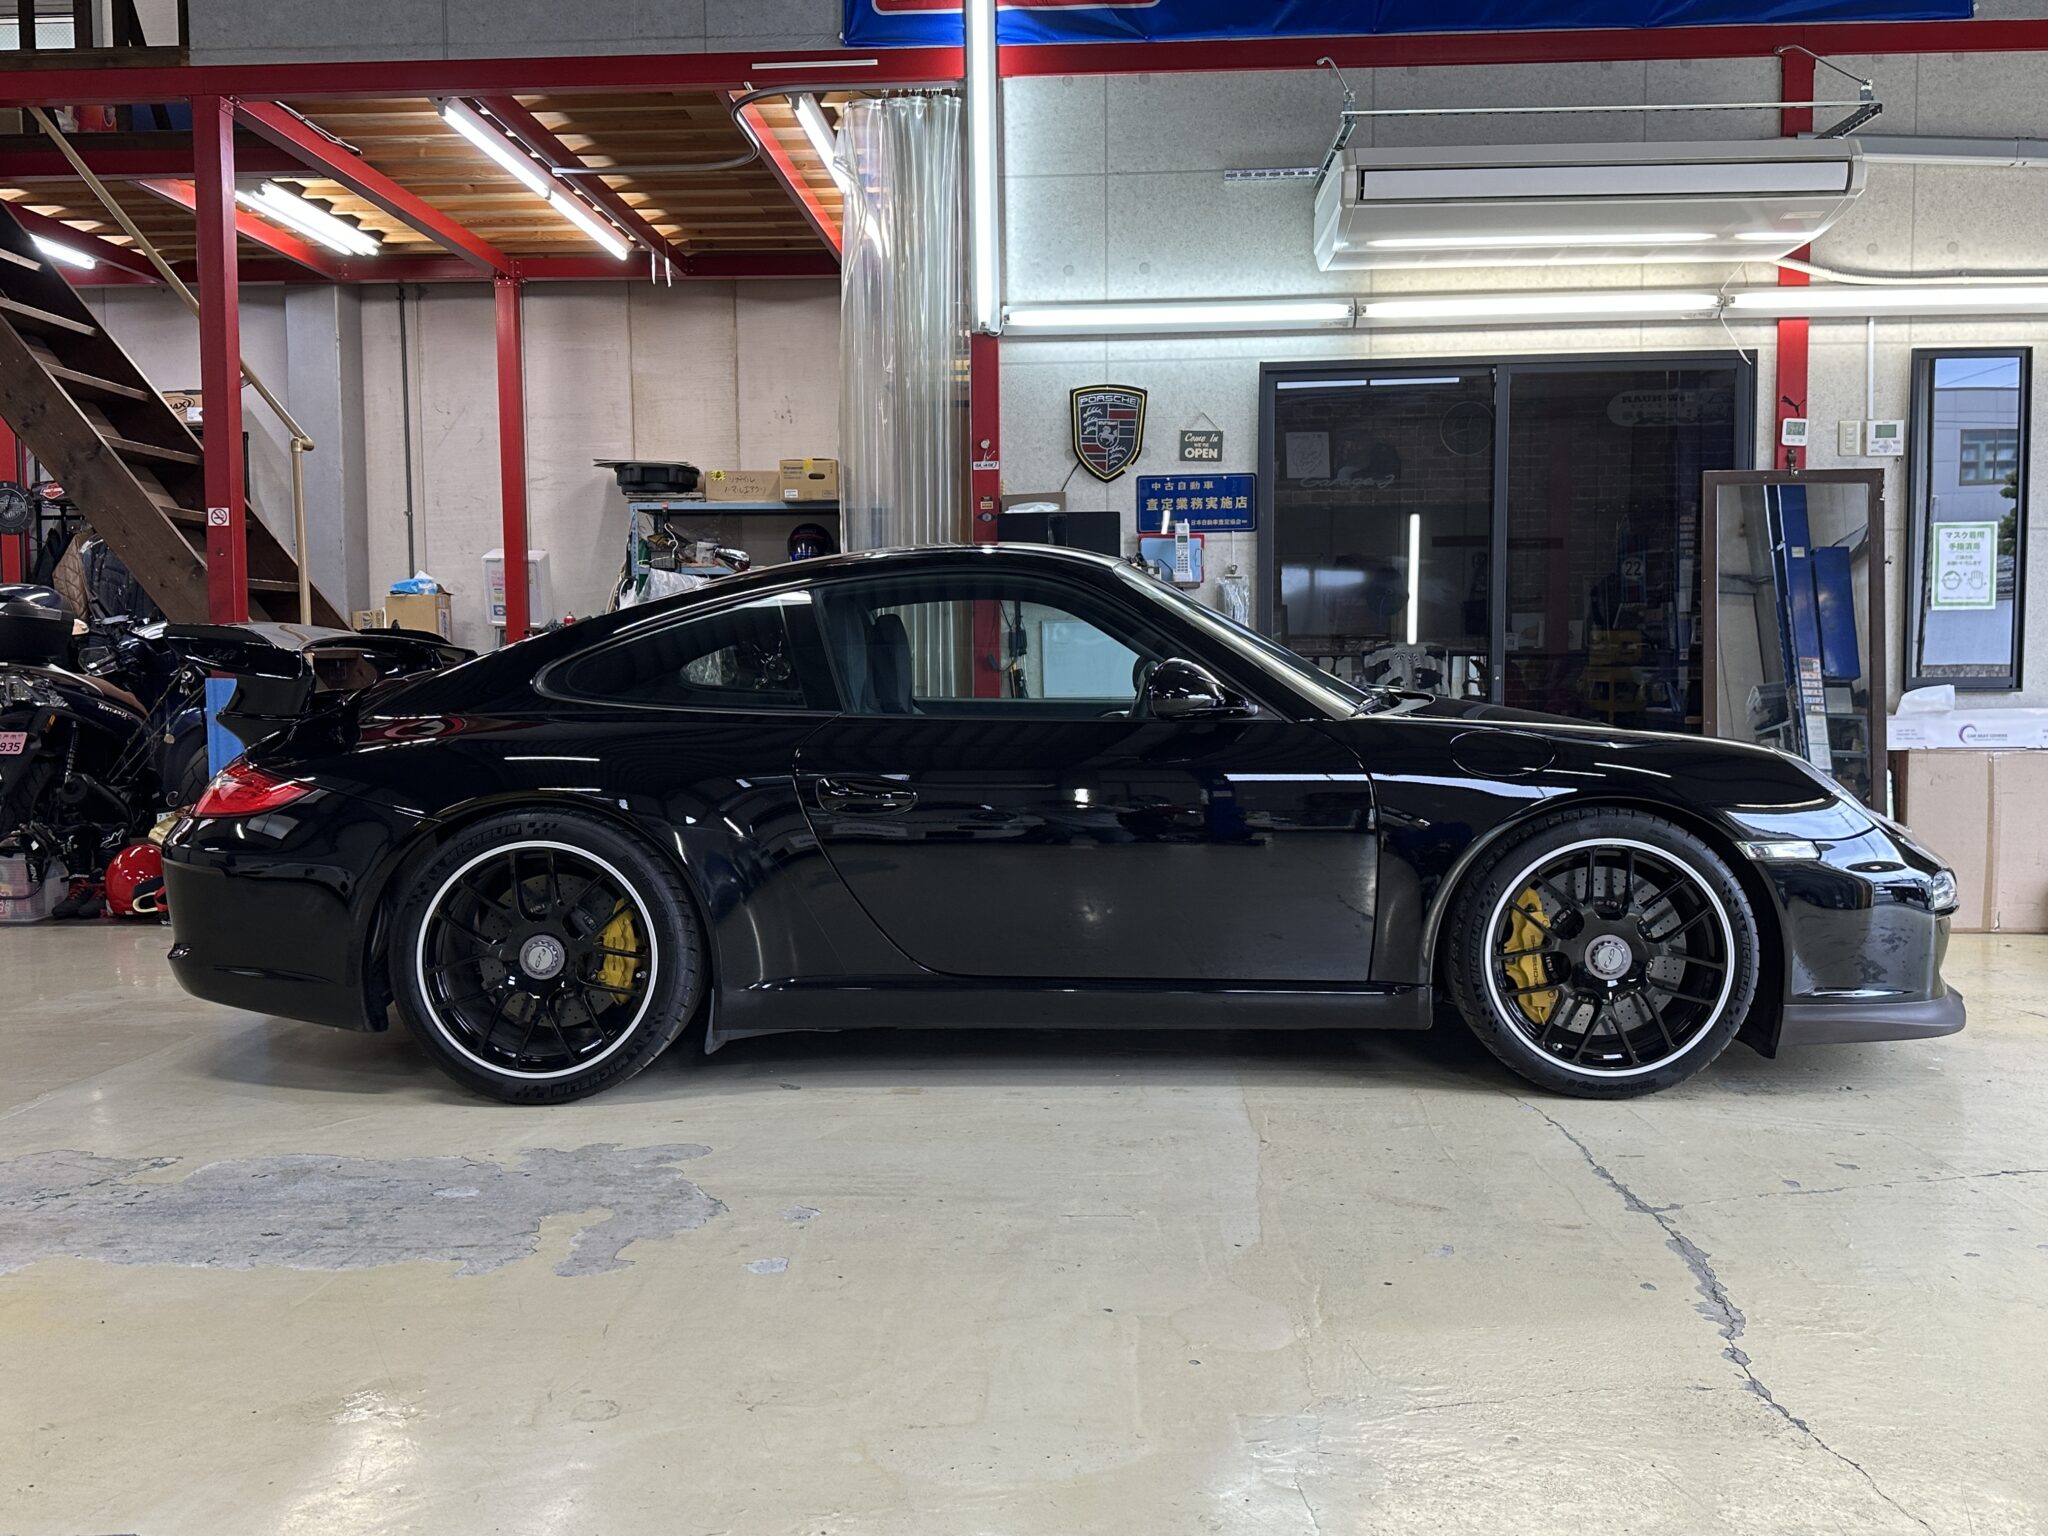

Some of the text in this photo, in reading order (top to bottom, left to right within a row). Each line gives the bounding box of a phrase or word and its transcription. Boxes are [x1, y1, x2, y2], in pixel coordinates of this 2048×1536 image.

[169, 401, 187, 410] AX
[1079, 395, 1138, 406] PORSCHE
[1184, 432, 1219, 443] Come In
[1184, 447, 1218, 459] OPEN
[1151, 481, 1214, 491] 中古自動車
[1146, 496, 1248, 511] 査定業務実施店
[1625, 561, 1641, 576] 22
[443, 823, 522, 863] MICHELIN
[1469, 914, 1486, 984] MICHELIN
[1734, 927, 1752, 1003] MICHELIN
[551, 1054, 630, 1098] MICHELIN
